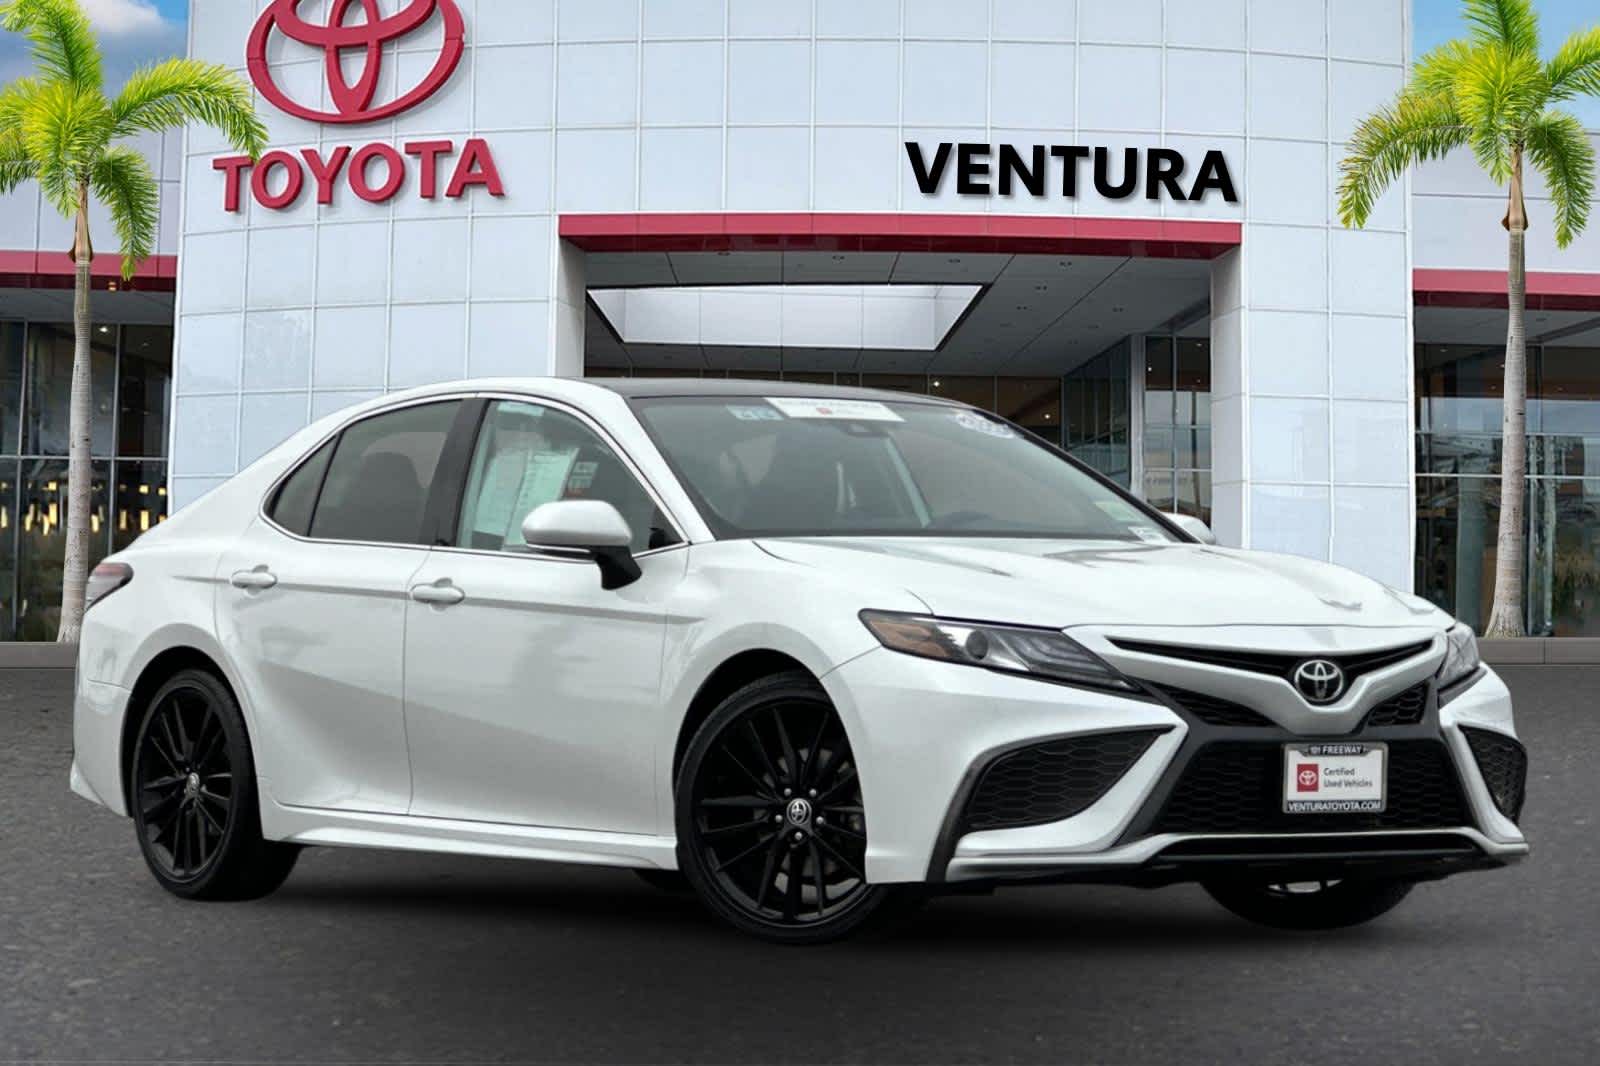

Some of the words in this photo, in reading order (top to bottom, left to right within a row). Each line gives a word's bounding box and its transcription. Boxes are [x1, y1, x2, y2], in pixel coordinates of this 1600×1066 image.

[212, 138, 505, 212] TOYOTA
[904, 142, 1238, 203] VENTURA
[1322, 745, 1362, 754] FREEWAY
[1323, 767, 1355, 776] Certified
[1323, 780, 1342, 788] Used
[1344, 779, 1373, 788] Vehicles
[1288, 801, 1381, 811] VENTURATOYOTA.COM
